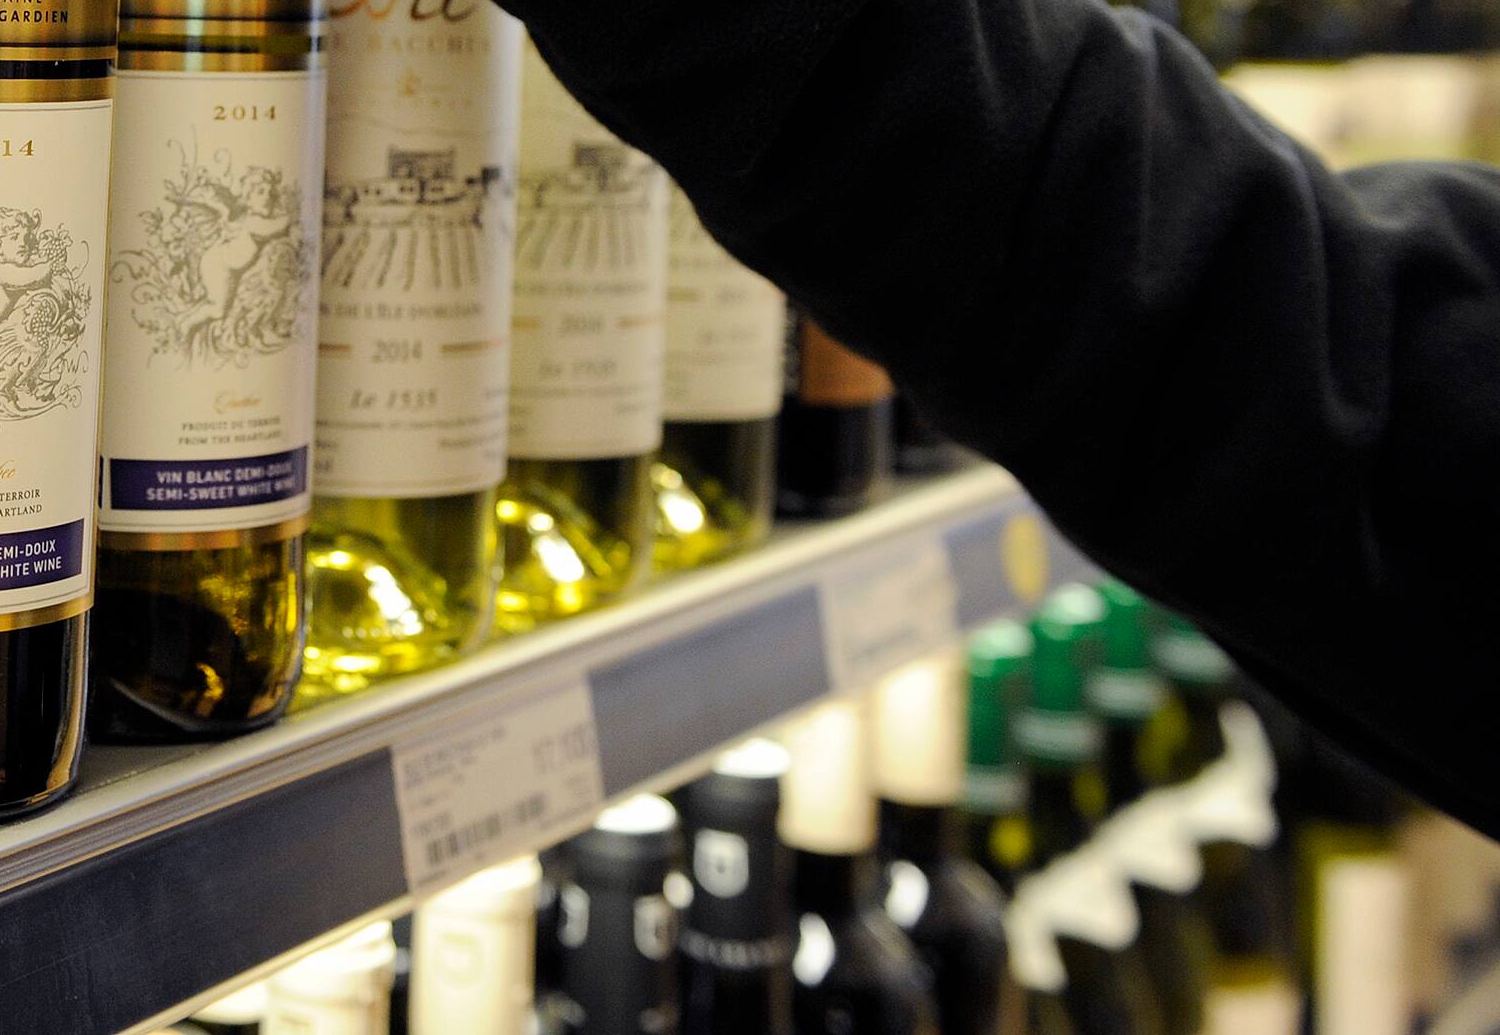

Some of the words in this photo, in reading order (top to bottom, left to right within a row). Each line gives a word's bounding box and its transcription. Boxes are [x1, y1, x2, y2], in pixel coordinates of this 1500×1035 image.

[214, 105, 277, 121] 2014
[157, 470, 182, 484] VIN
[186, 468, 232, 484] BLANC
[146, 485, 234, 501] SEMI-SWEET
[237, 481, 272, 497] WHITE
[33, 555, 63, 575] WINE
